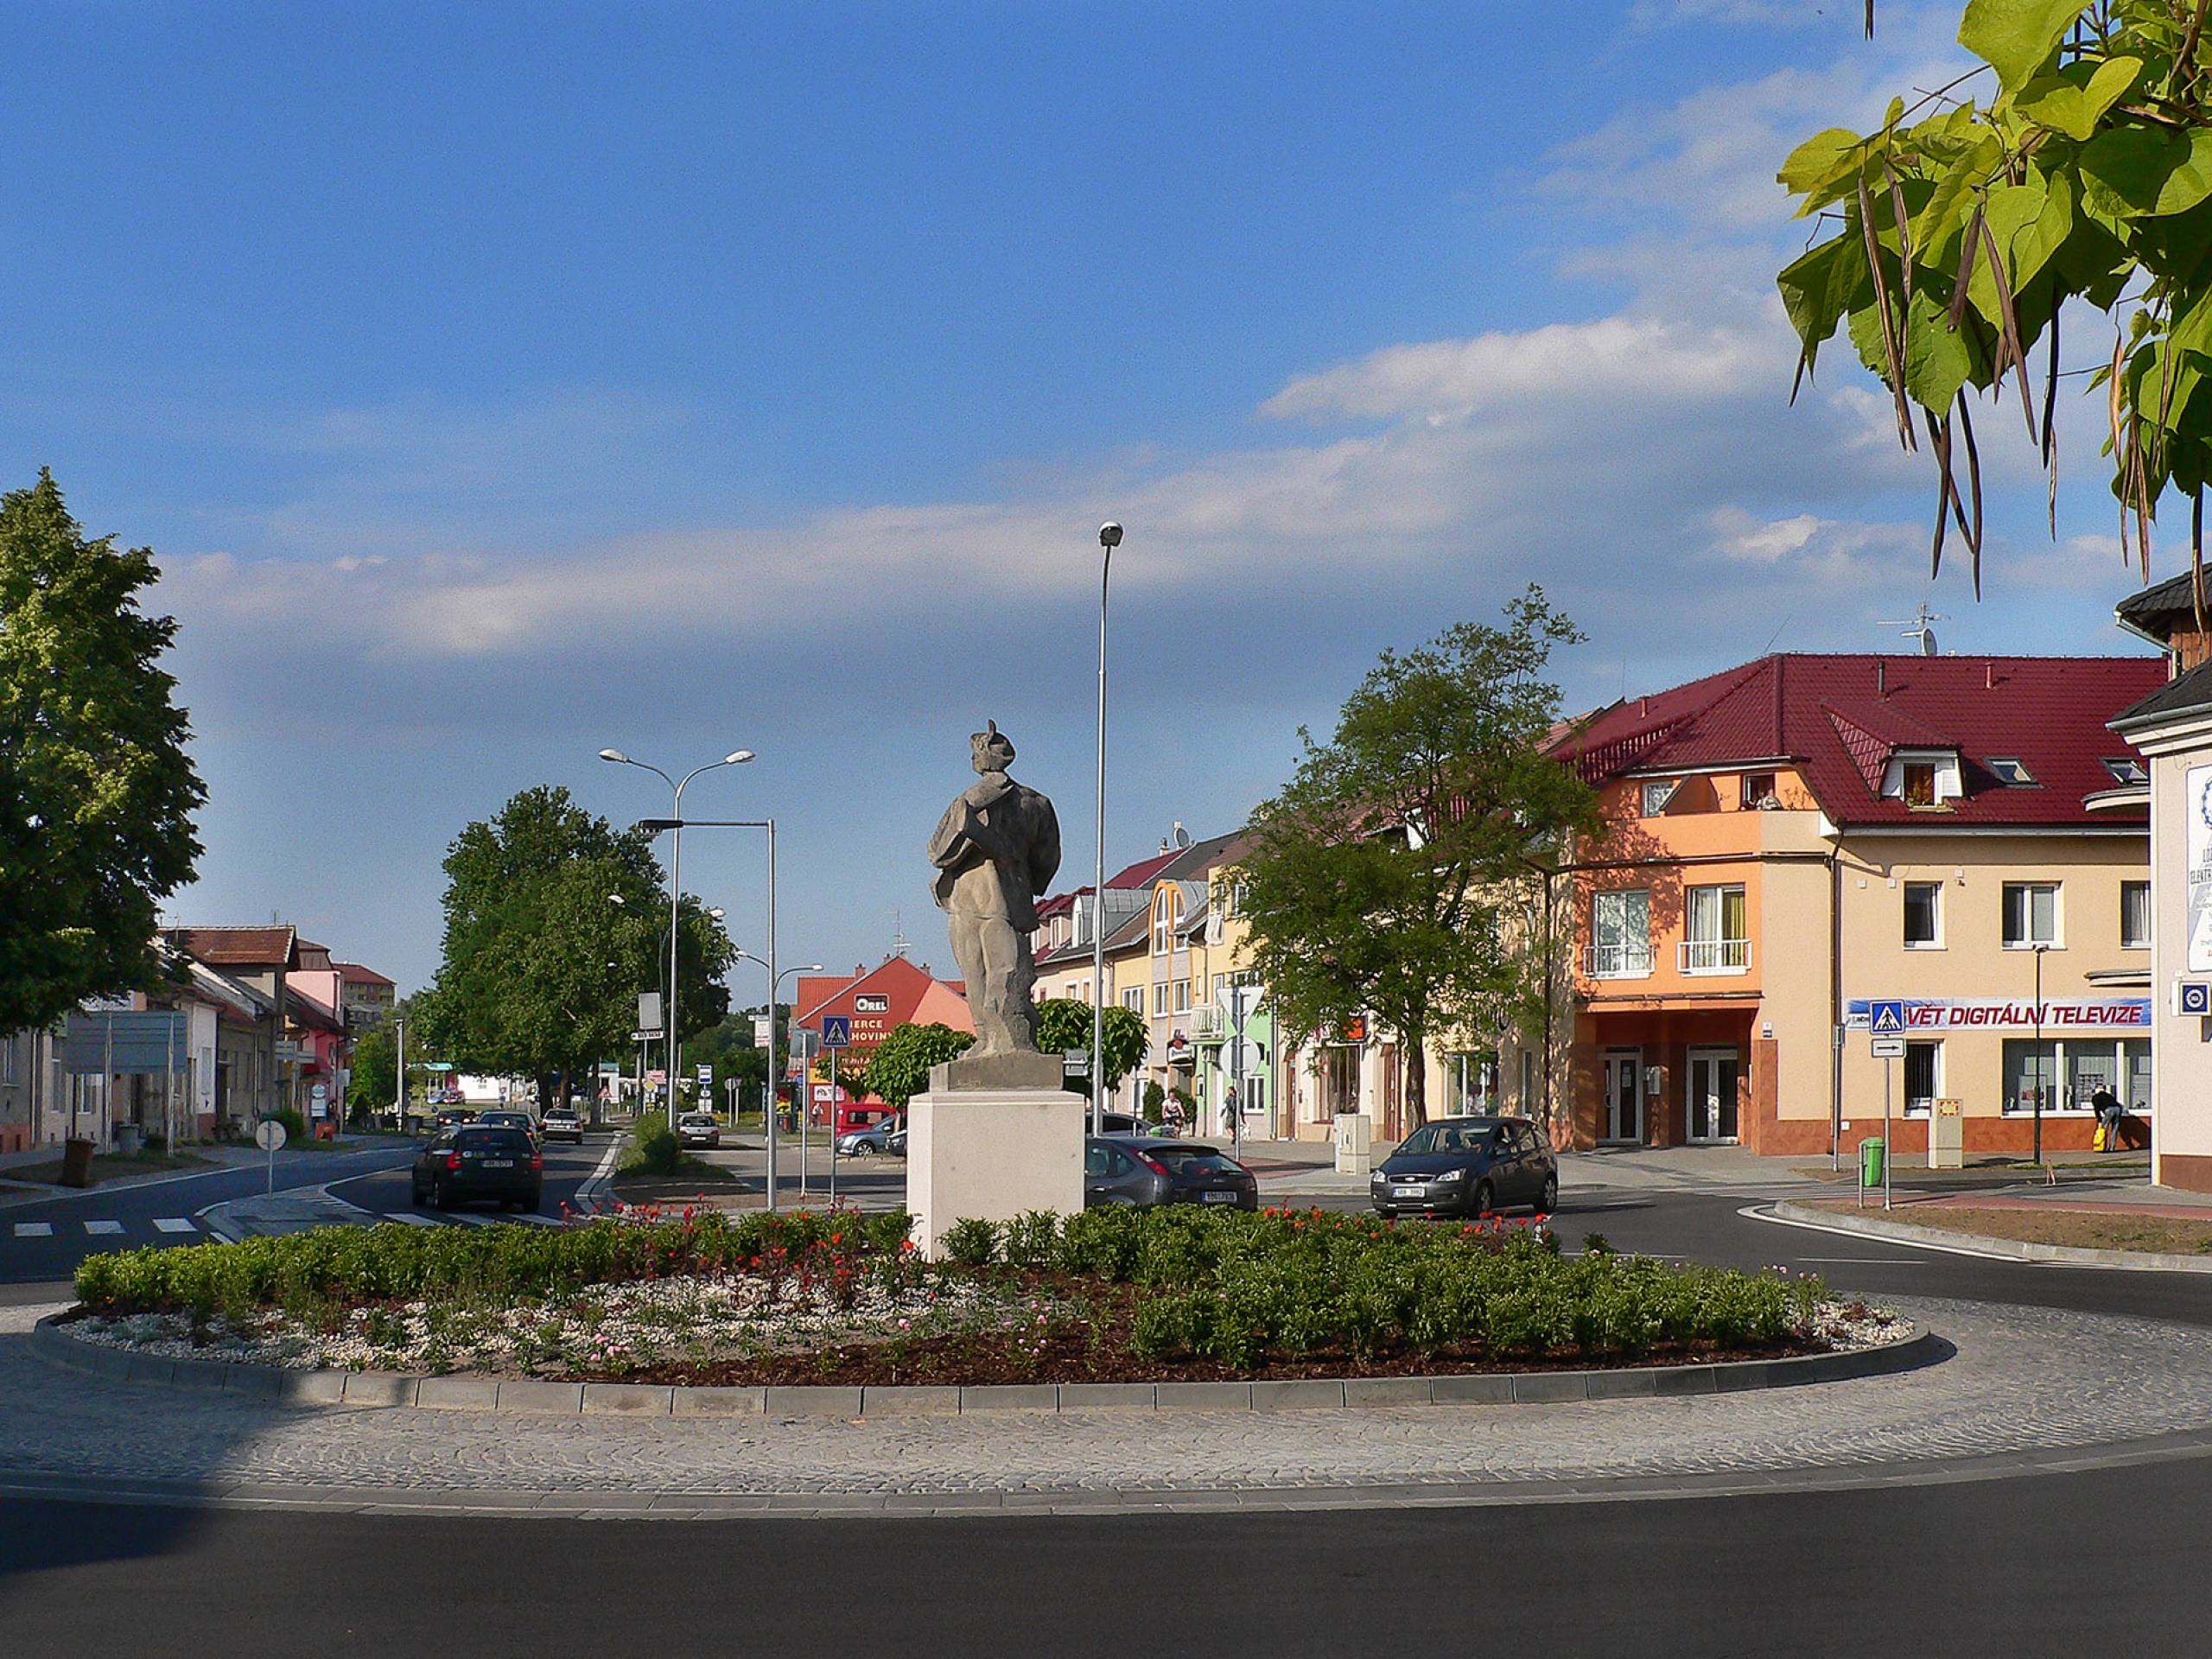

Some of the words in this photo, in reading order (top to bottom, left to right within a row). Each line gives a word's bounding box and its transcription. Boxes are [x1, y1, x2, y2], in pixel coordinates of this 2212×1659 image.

[857, 998, 887, 1010] OREL
[1904, 1003, 1947, 1025] VĚT
[1949, 1002, 2049, 1025] DIGITÁLNÍ
[2052, 1006, 2143, 1024] TELEVIZE
[850, 1020, 883, 1028] ERCE
